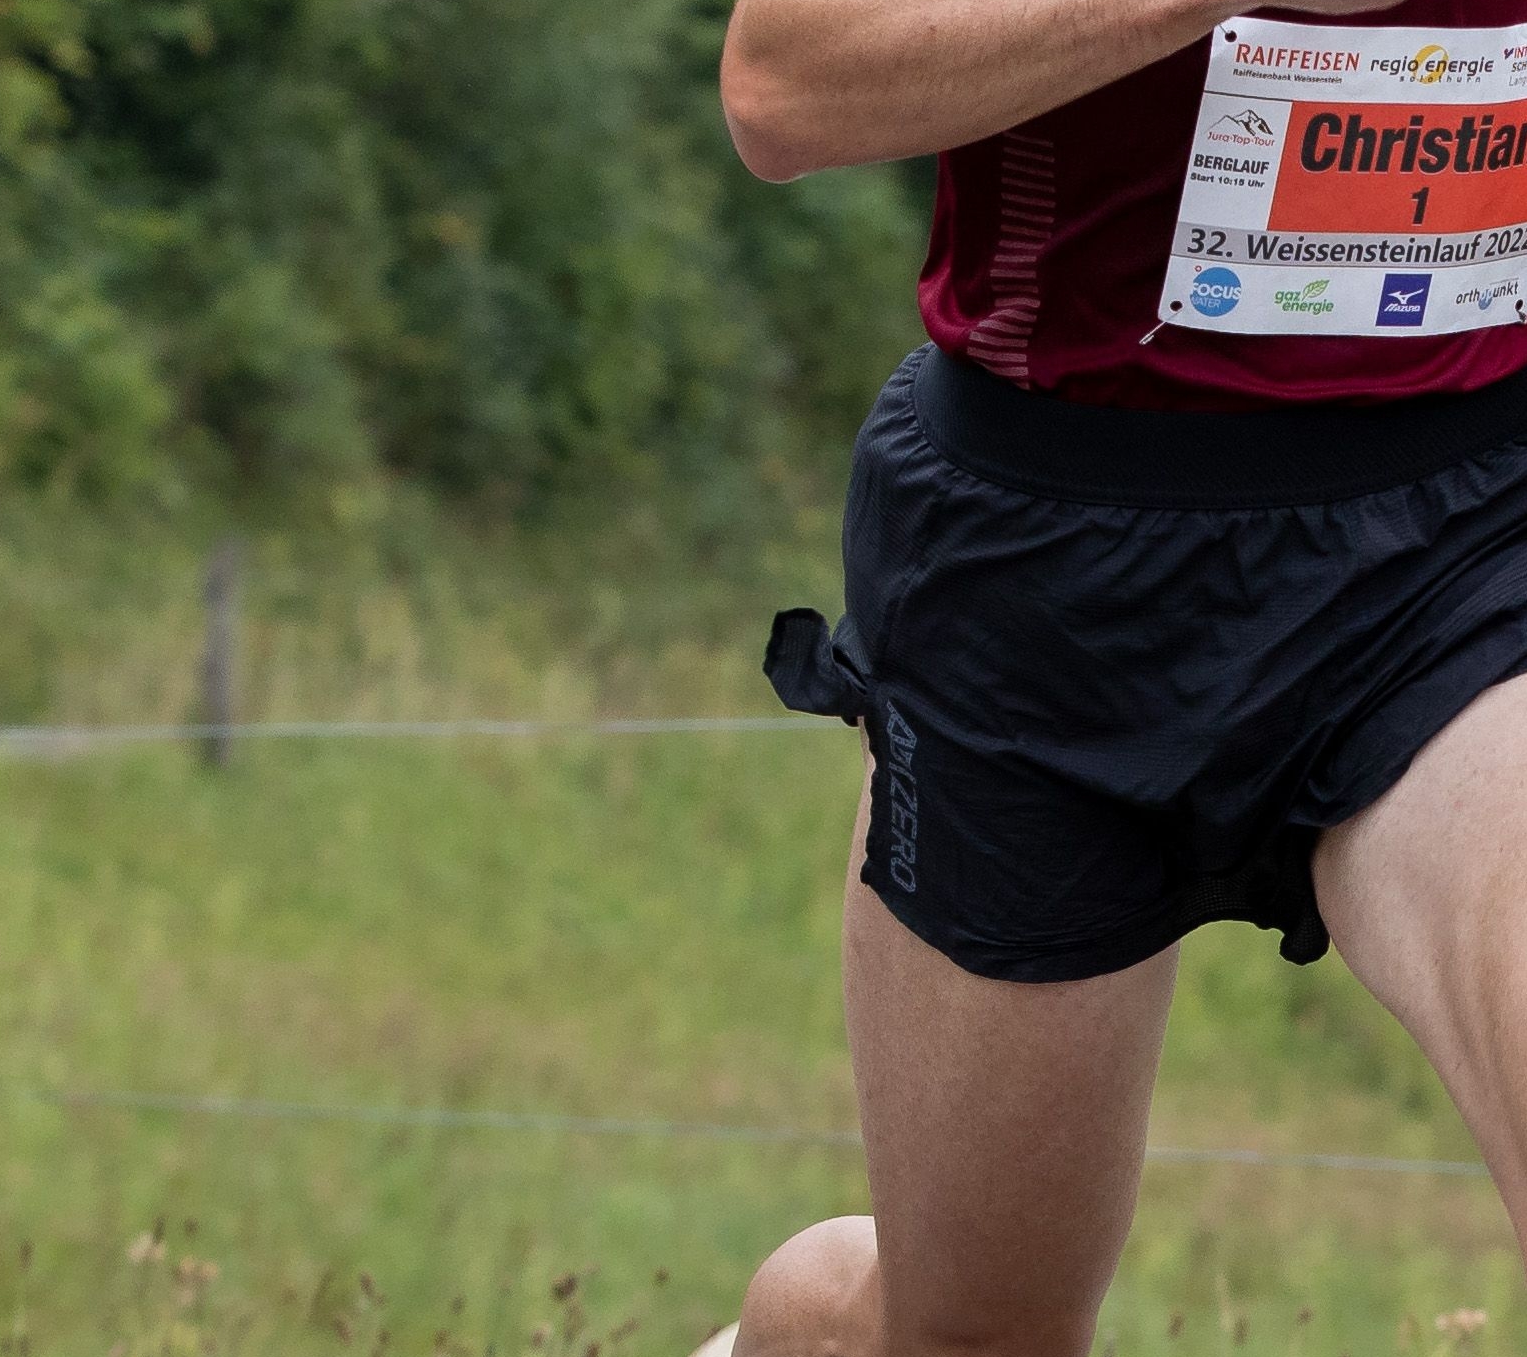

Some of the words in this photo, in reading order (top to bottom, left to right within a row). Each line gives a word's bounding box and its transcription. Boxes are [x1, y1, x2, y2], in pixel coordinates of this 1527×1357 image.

[1235, 43, 1360, 72] RAIFFEISEN
[1370, 55, 1419, 76] regio
[1424, 55, 1495, 77] energie
[1193, 153, 1270, 175] BERGLAUF
[1190, 172, 1215, 183] Start
[1218, 176, 1245, 187] 10:15
[1247, 180, 1266, 189] Uhr
[1410, 187, 1430, 225] 1
[1186, 228, 1234, 258] 32.
[1246, 233, 1483, 264] Weissensteinlauf
[1274, 290, 1301, 304] gaz
[1281, 299, 1335, 315] energie
